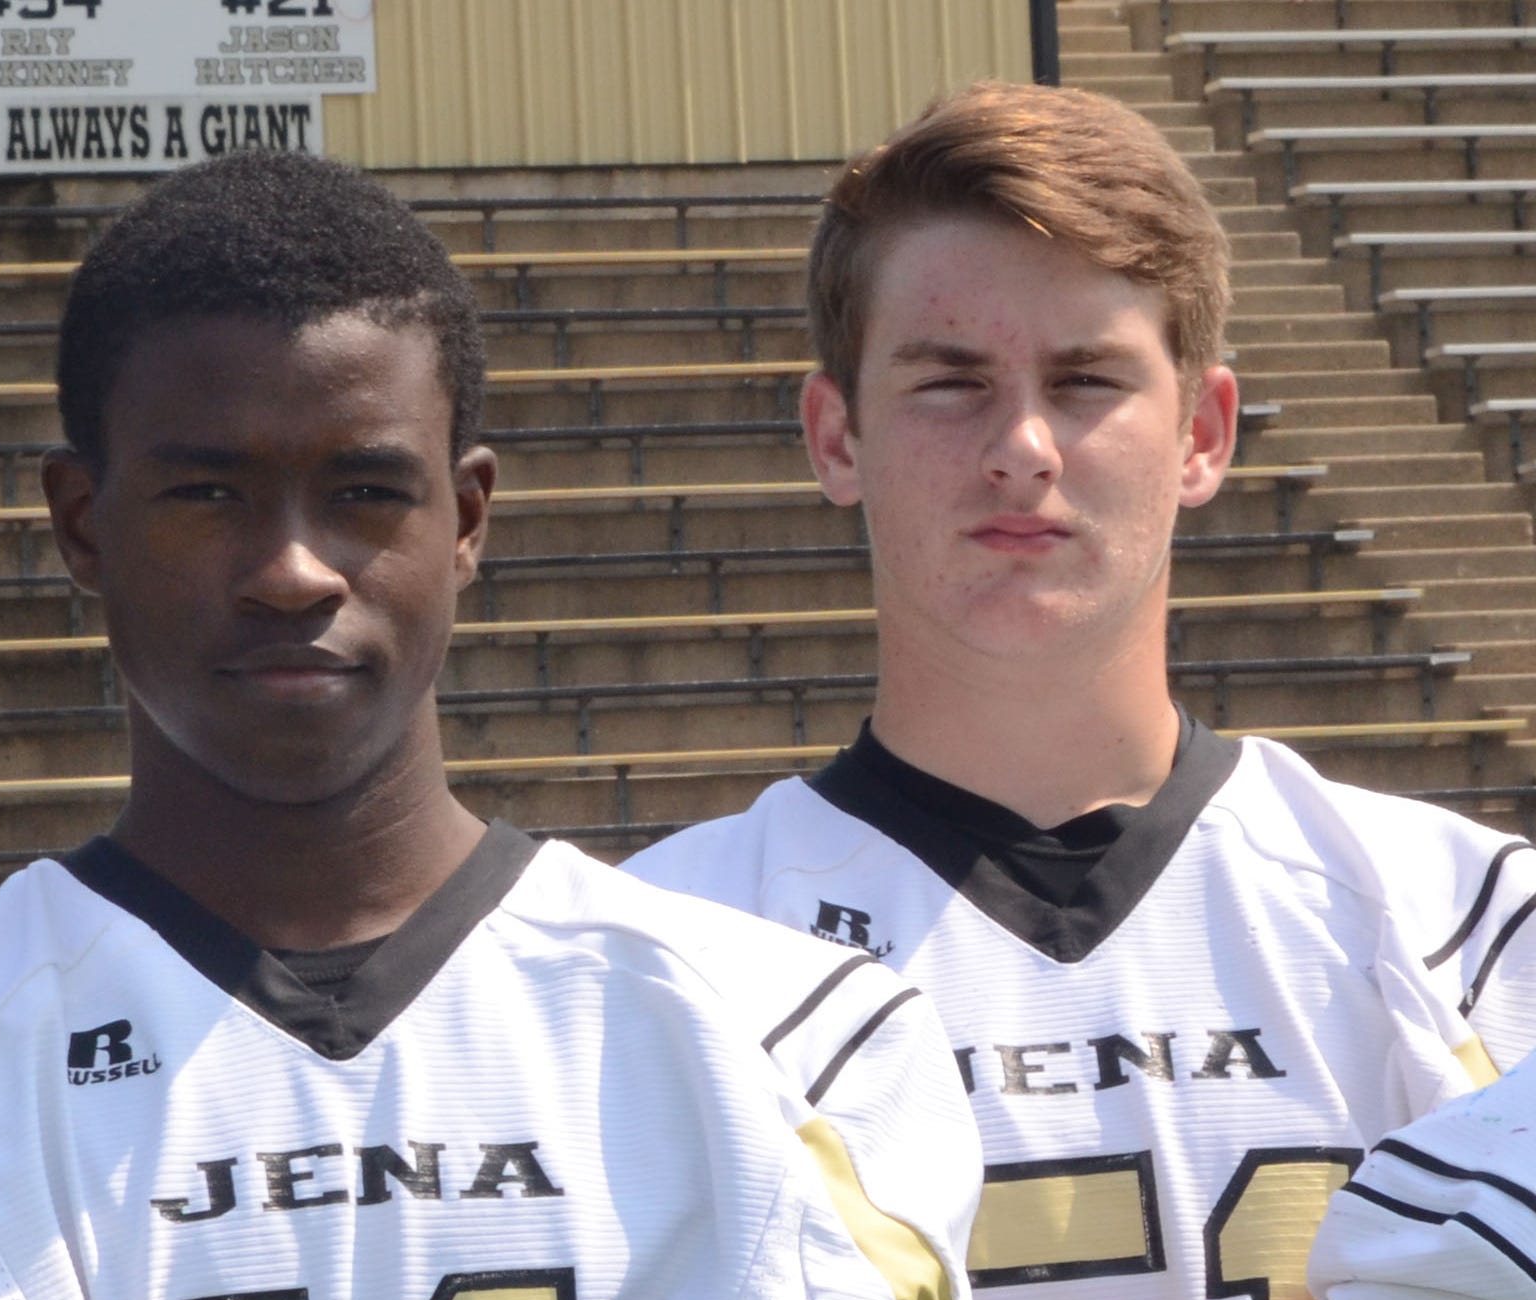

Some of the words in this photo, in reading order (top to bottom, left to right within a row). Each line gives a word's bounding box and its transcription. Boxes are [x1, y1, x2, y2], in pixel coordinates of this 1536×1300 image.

[1, 27, 75, 55] RAY
[219, 25, 340, 53] JASON
[195, 56, 366, 85] HATCHER
[7, 105, 151, 160] ALWAYS
[164, 106, 188, 158] A
[200, 104, 311, 154] GIANT
[68, 1019, 132, 1068] R
[151, 1140, 563, 1222] JENA
